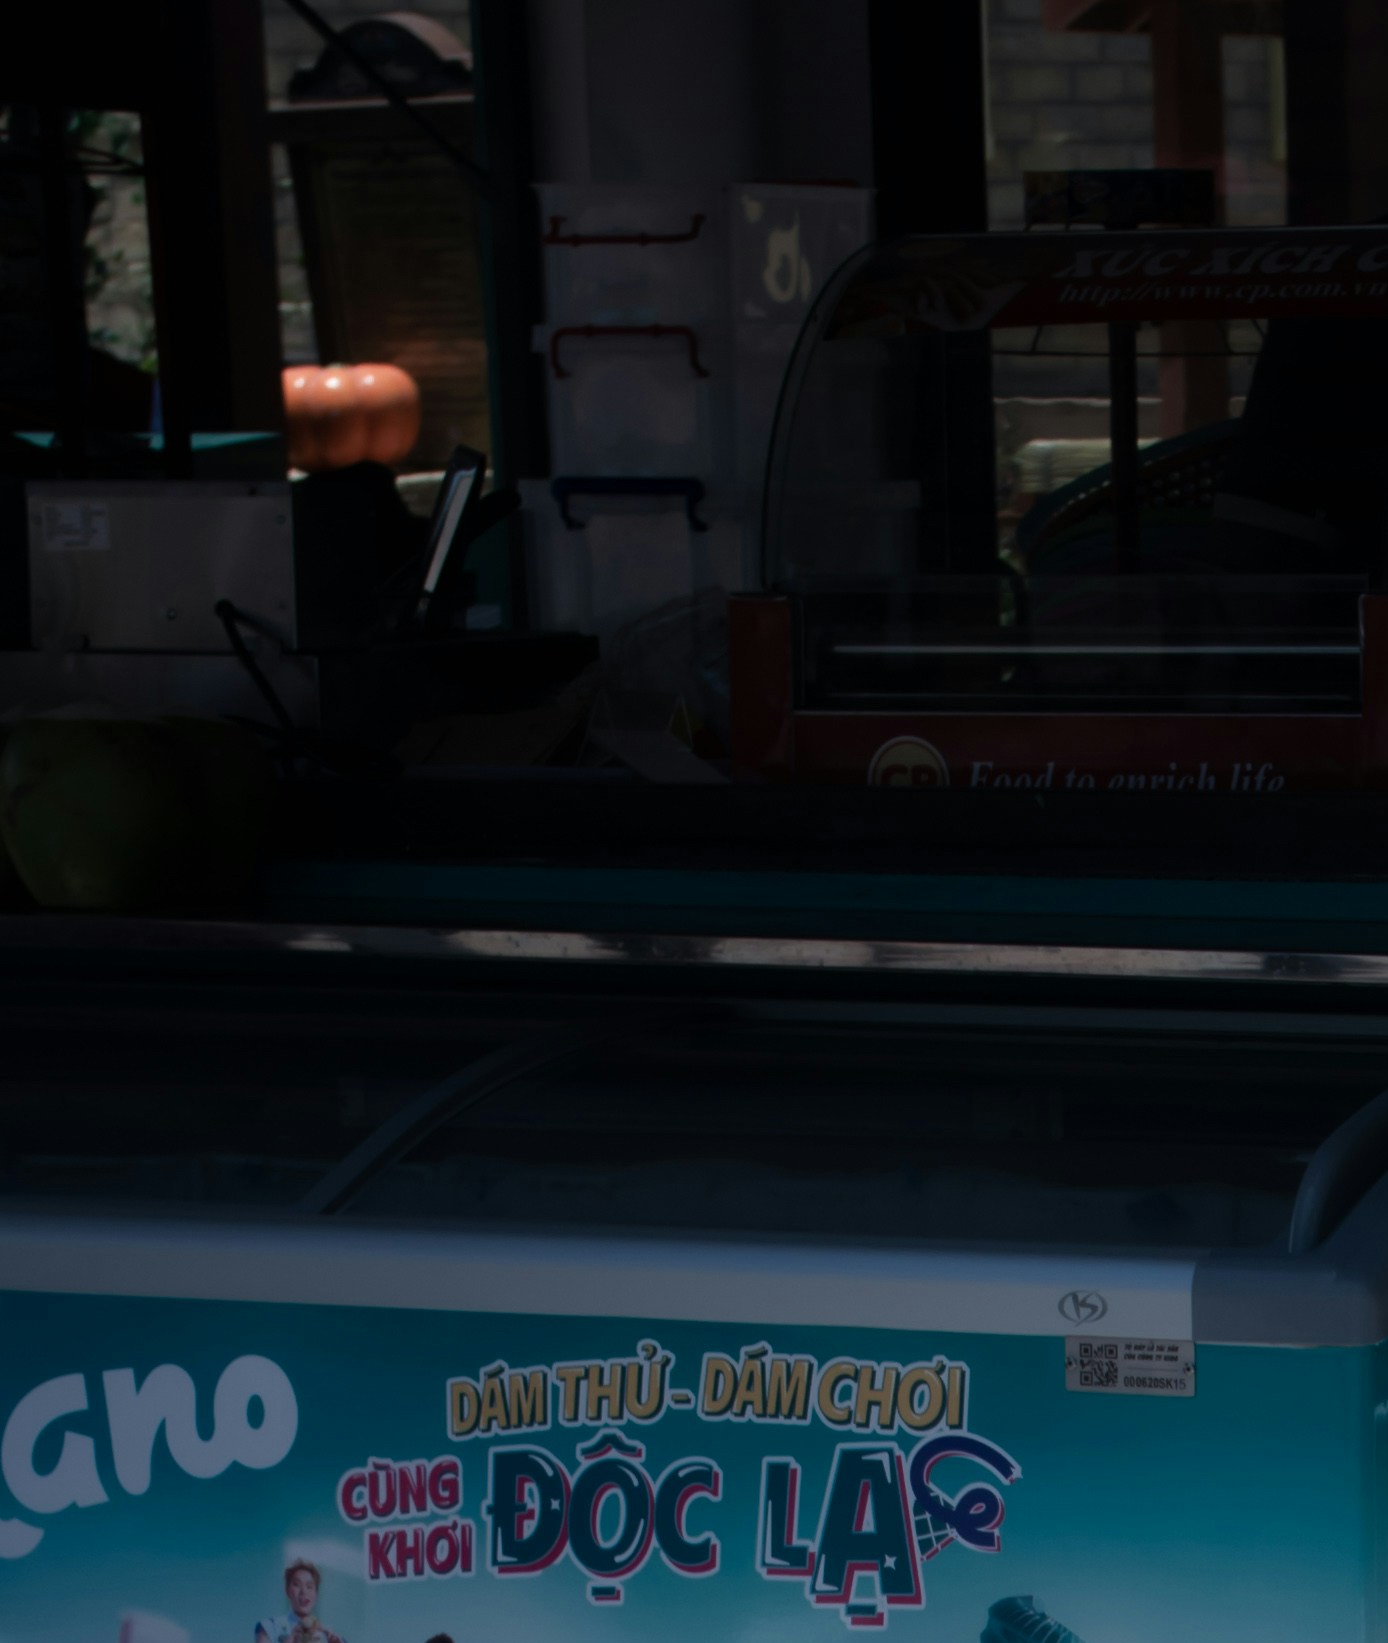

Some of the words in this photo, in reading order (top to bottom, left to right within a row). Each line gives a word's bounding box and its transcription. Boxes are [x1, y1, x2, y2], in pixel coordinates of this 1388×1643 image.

[1052, 243, 1190, 278] XÚC
[1190, 241, 1351, 275] XÍCH
[970, 761, 1056, 789] Food
[1065, 765, 1097, 789] to
[1108, 762, 1216, 789] enrich
[1230, 763, 1287, 790] life
[451, 1364, 548, 1436] DÁM
[557, 1344, 672, 1426] THỬ
[703, 1347, 812, 1420] DÁM
[818, 1360, 967, 1431] CHƠI
[341, 1460, 460, 1521] CÙNG
[487, 1436, 720, 1602] ĐỘC
[368, 1519, 472, 1580] KHƠI
